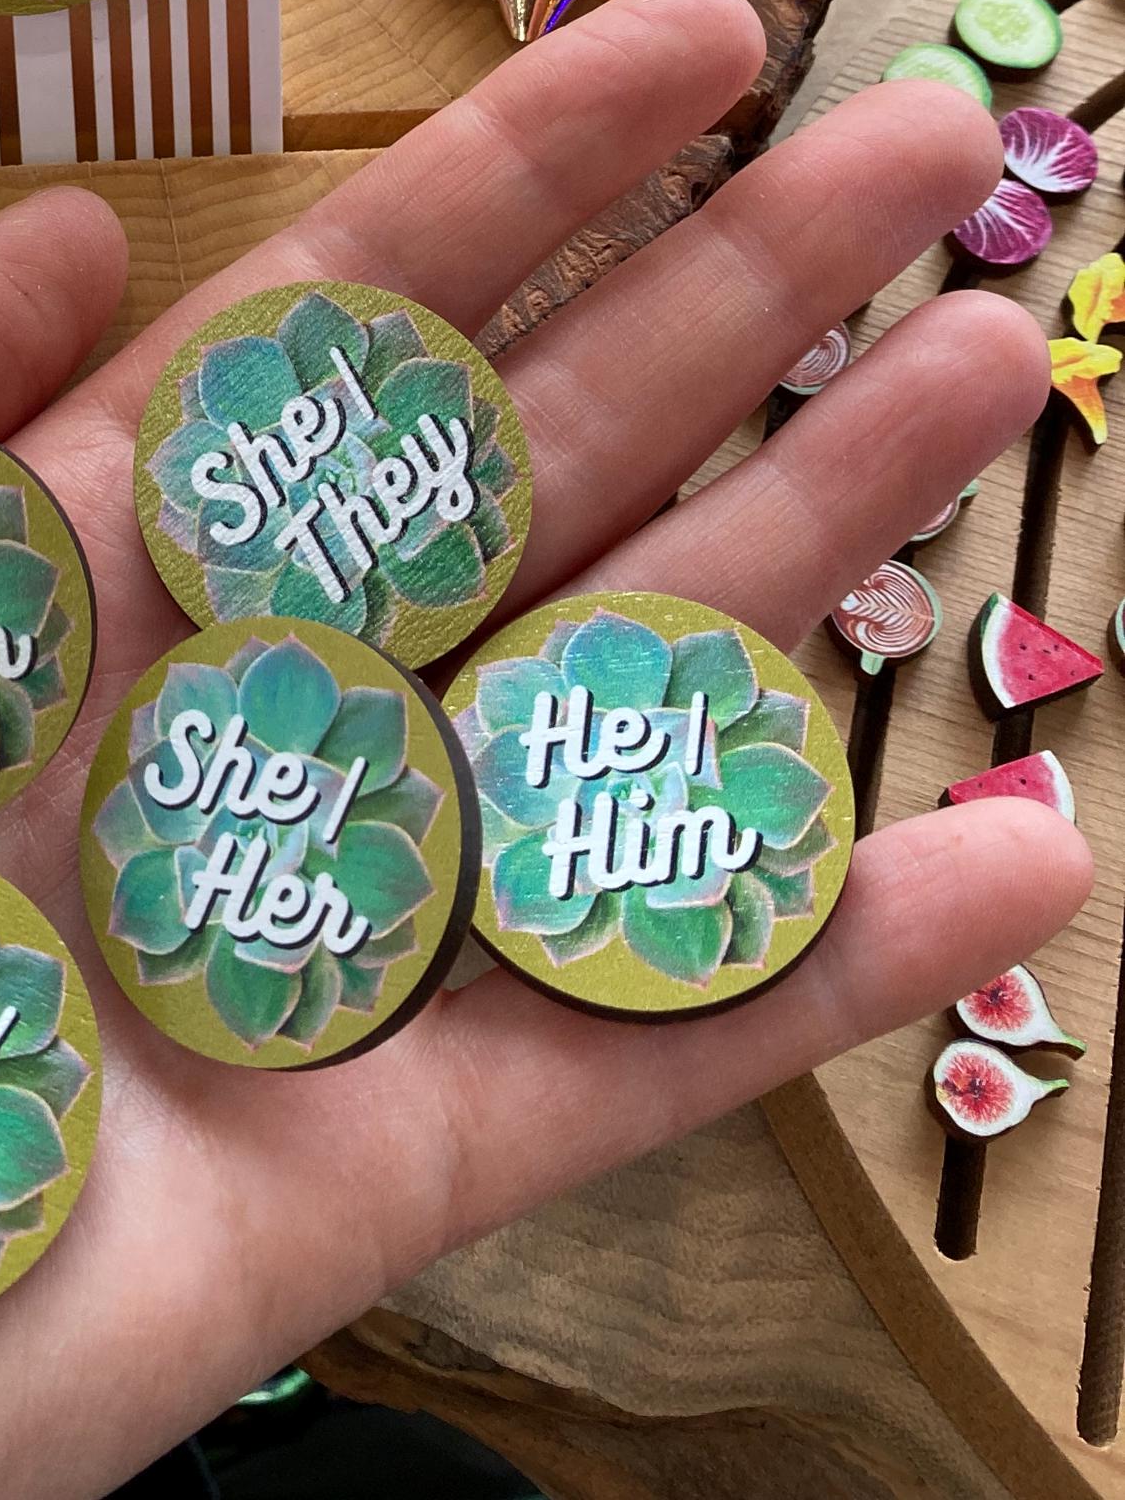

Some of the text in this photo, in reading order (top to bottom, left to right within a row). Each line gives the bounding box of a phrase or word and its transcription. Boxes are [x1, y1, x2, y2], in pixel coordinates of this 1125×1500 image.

[274, 414, 475, 603] They
[185, 831, 368, 954] Her
[545, 798, 761, 900] Him
